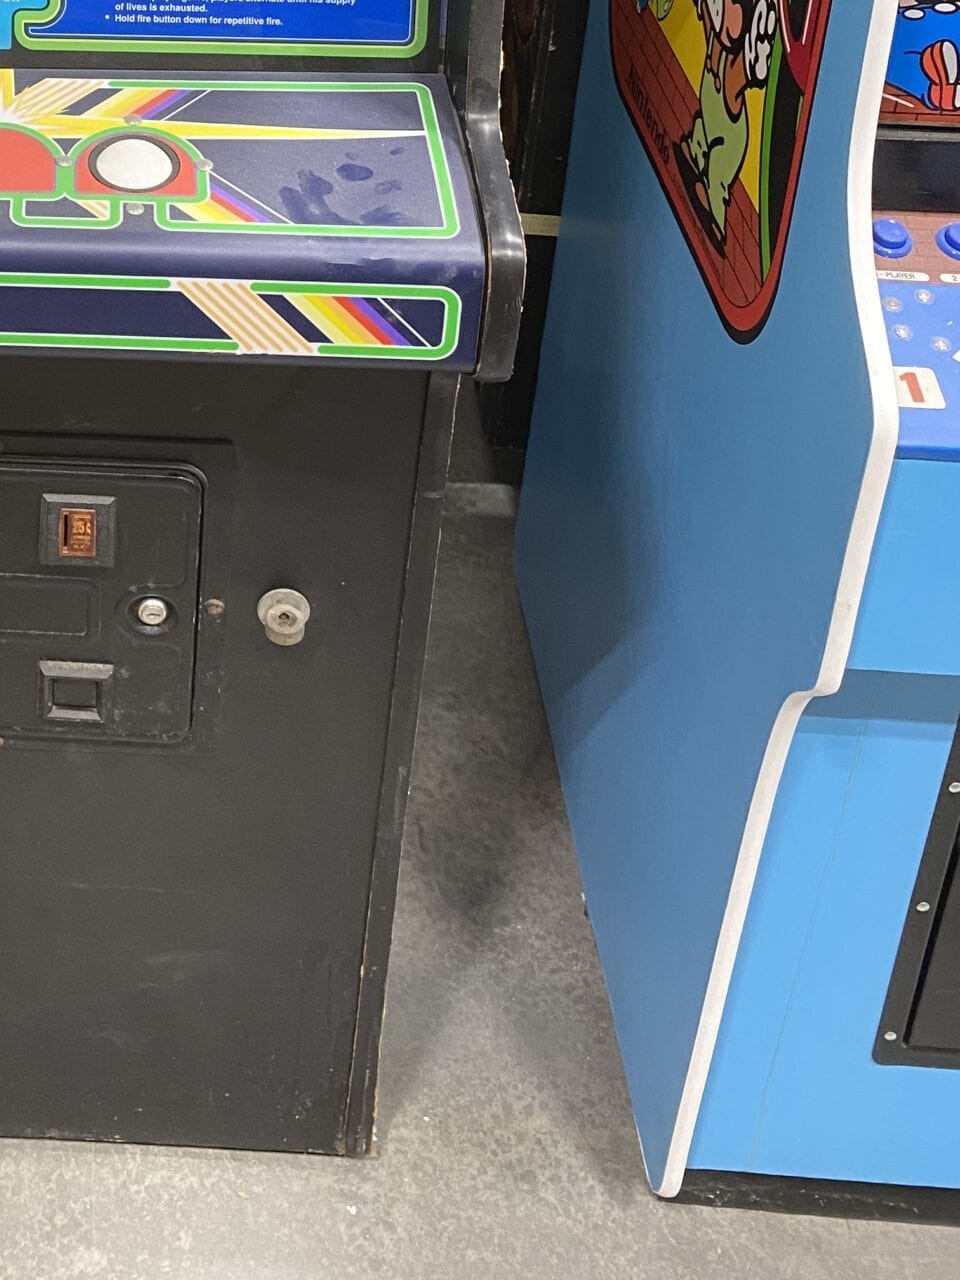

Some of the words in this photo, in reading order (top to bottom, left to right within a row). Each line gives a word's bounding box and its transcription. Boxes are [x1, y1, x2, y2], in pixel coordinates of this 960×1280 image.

[114, 2, 125, 11] of
[126, 2, 148, 11] lives
[149, 2, 158, 12] is
[159, 3, 209, 13] exhausted.
[114, 13, 136, 23] Hold
[136, 14, 152, 23] fire
[153, 14, 182, 24] button
[183, 15, 208, 24] down
[209, 15, 223, 25] for
[223, 16, 265, 27] repetitive
[266, 17, 284, 26] fire.
[627, 64, 670, 166] Nintendo
[899, 372, 925, 403] 1
